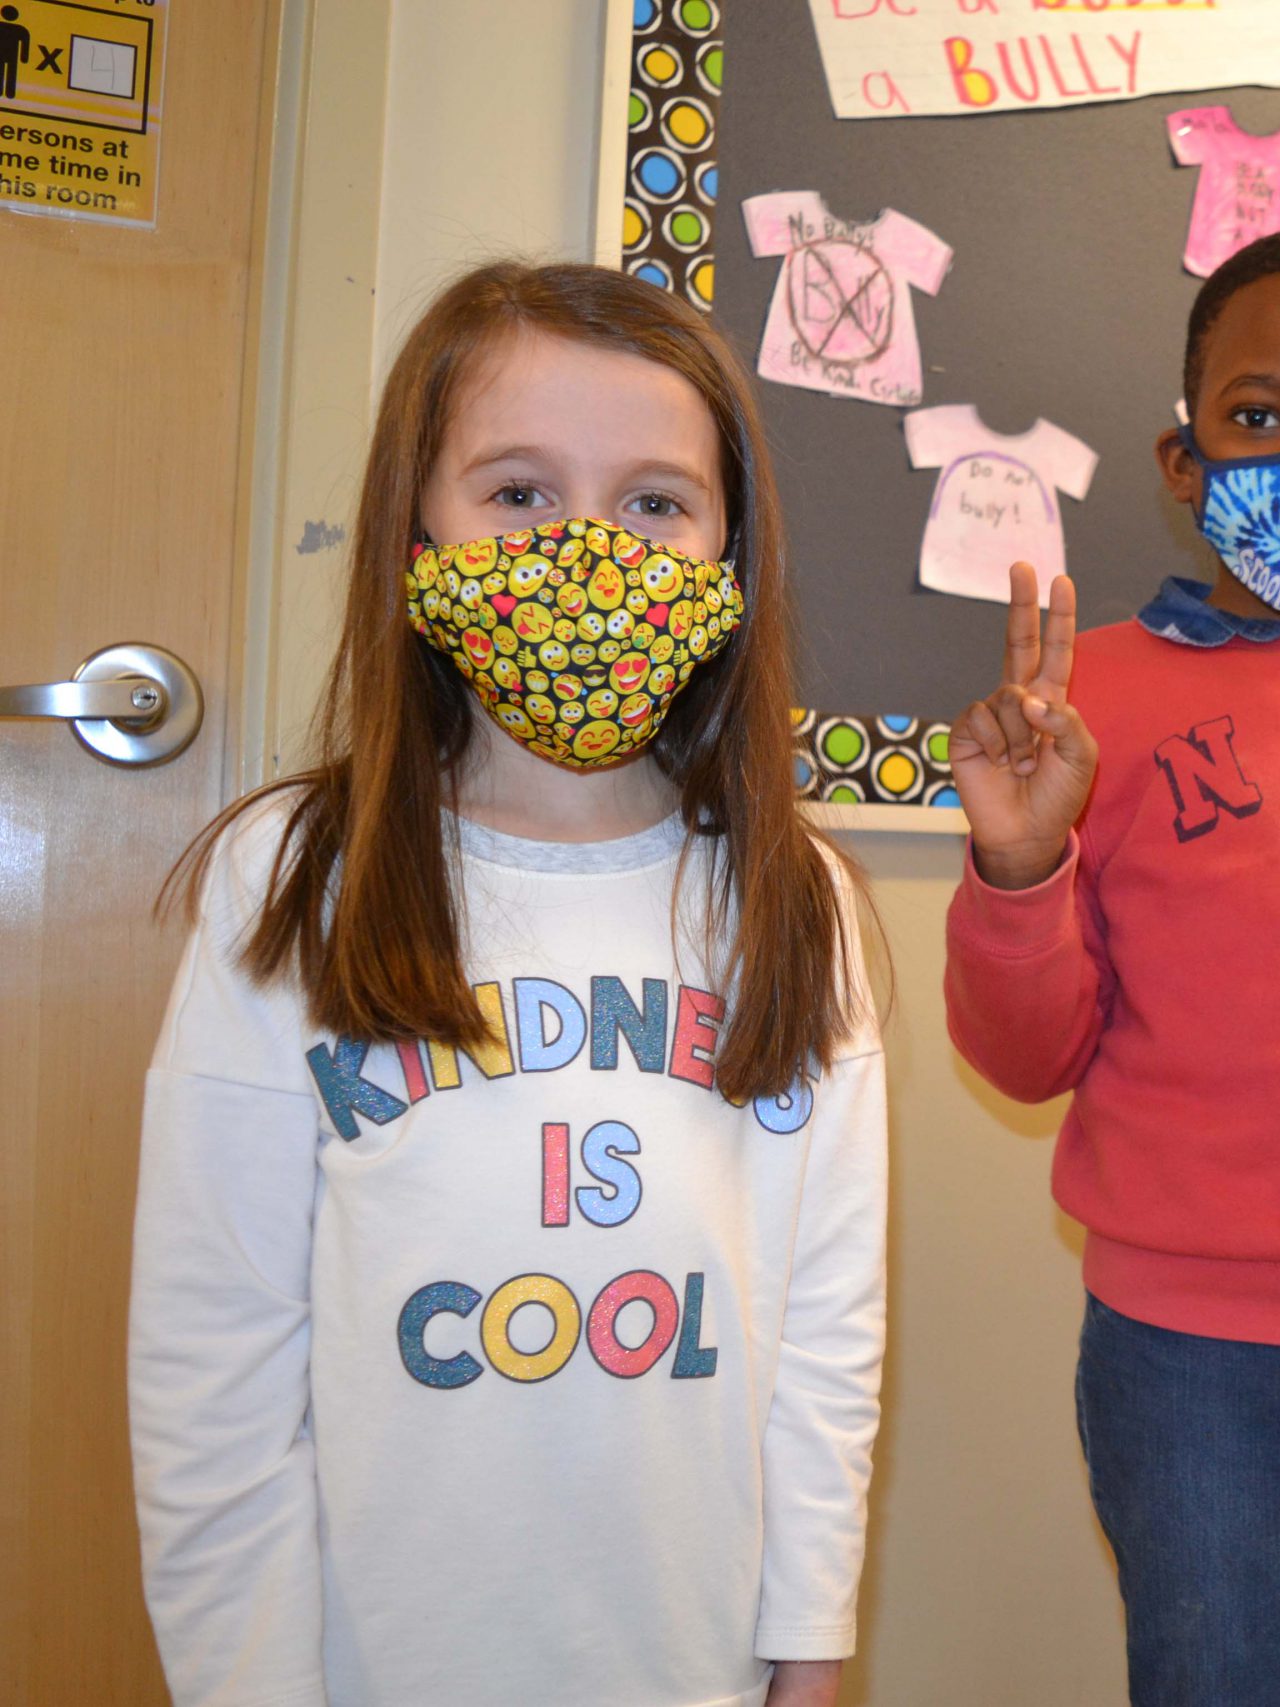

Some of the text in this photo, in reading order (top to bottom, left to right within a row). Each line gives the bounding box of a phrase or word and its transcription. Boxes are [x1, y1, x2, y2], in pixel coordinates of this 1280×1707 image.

[862, 31, 1142, 114] a BULLY
[49, 156, 109, 182] time
[118, 166, 141, 187] in
[102, 140, 129, 159] at
[46, 184, 117, 210] room
[541, 1119, 643, 1229] IS
[397, 1269, 718, 1390] COOL
